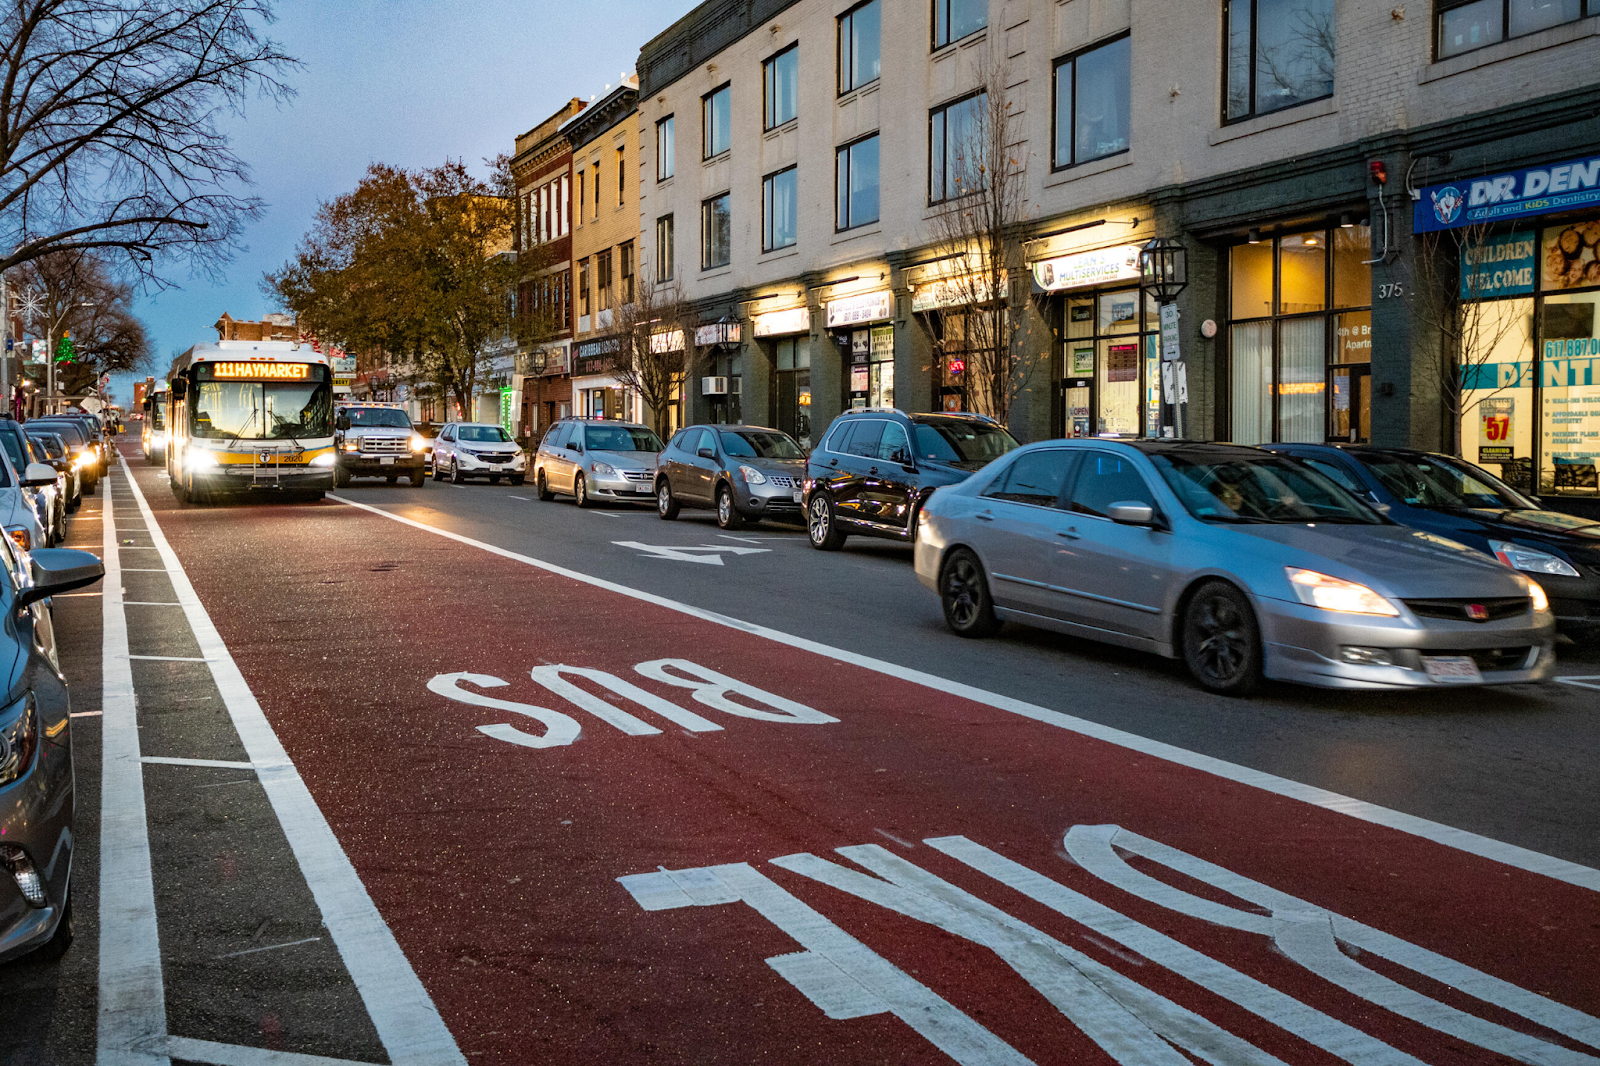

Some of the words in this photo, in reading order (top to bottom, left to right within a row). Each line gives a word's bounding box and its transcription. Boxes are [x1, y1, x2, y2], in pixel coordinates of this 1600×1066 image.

[1468, 175, 1521, 207] DR.
[1523, 160, 1600, 198] DEN
[1474, 206, 1500, 218] Adult
[1503, 203, 1522, 214] and
[1524, 199, 1550, 210] KIDS
[1465, 240, 1534, 266] CHILDREN
[1059, 262, 1120, 282] MULTISERVICES
[1465, 267, 1533, 290] WELCOME
[1378, 282, 1402, 299] 375
[1163, 321, 1177, 331] MINUTE
[214, 362, 235, 377] 111
[235, 363, 309, 378] HAYMARKET
[1073, 407, 1089, 415] OPEN
[284, 455, 303, 463] 2020
[426, 657, 842, 749] BUS
